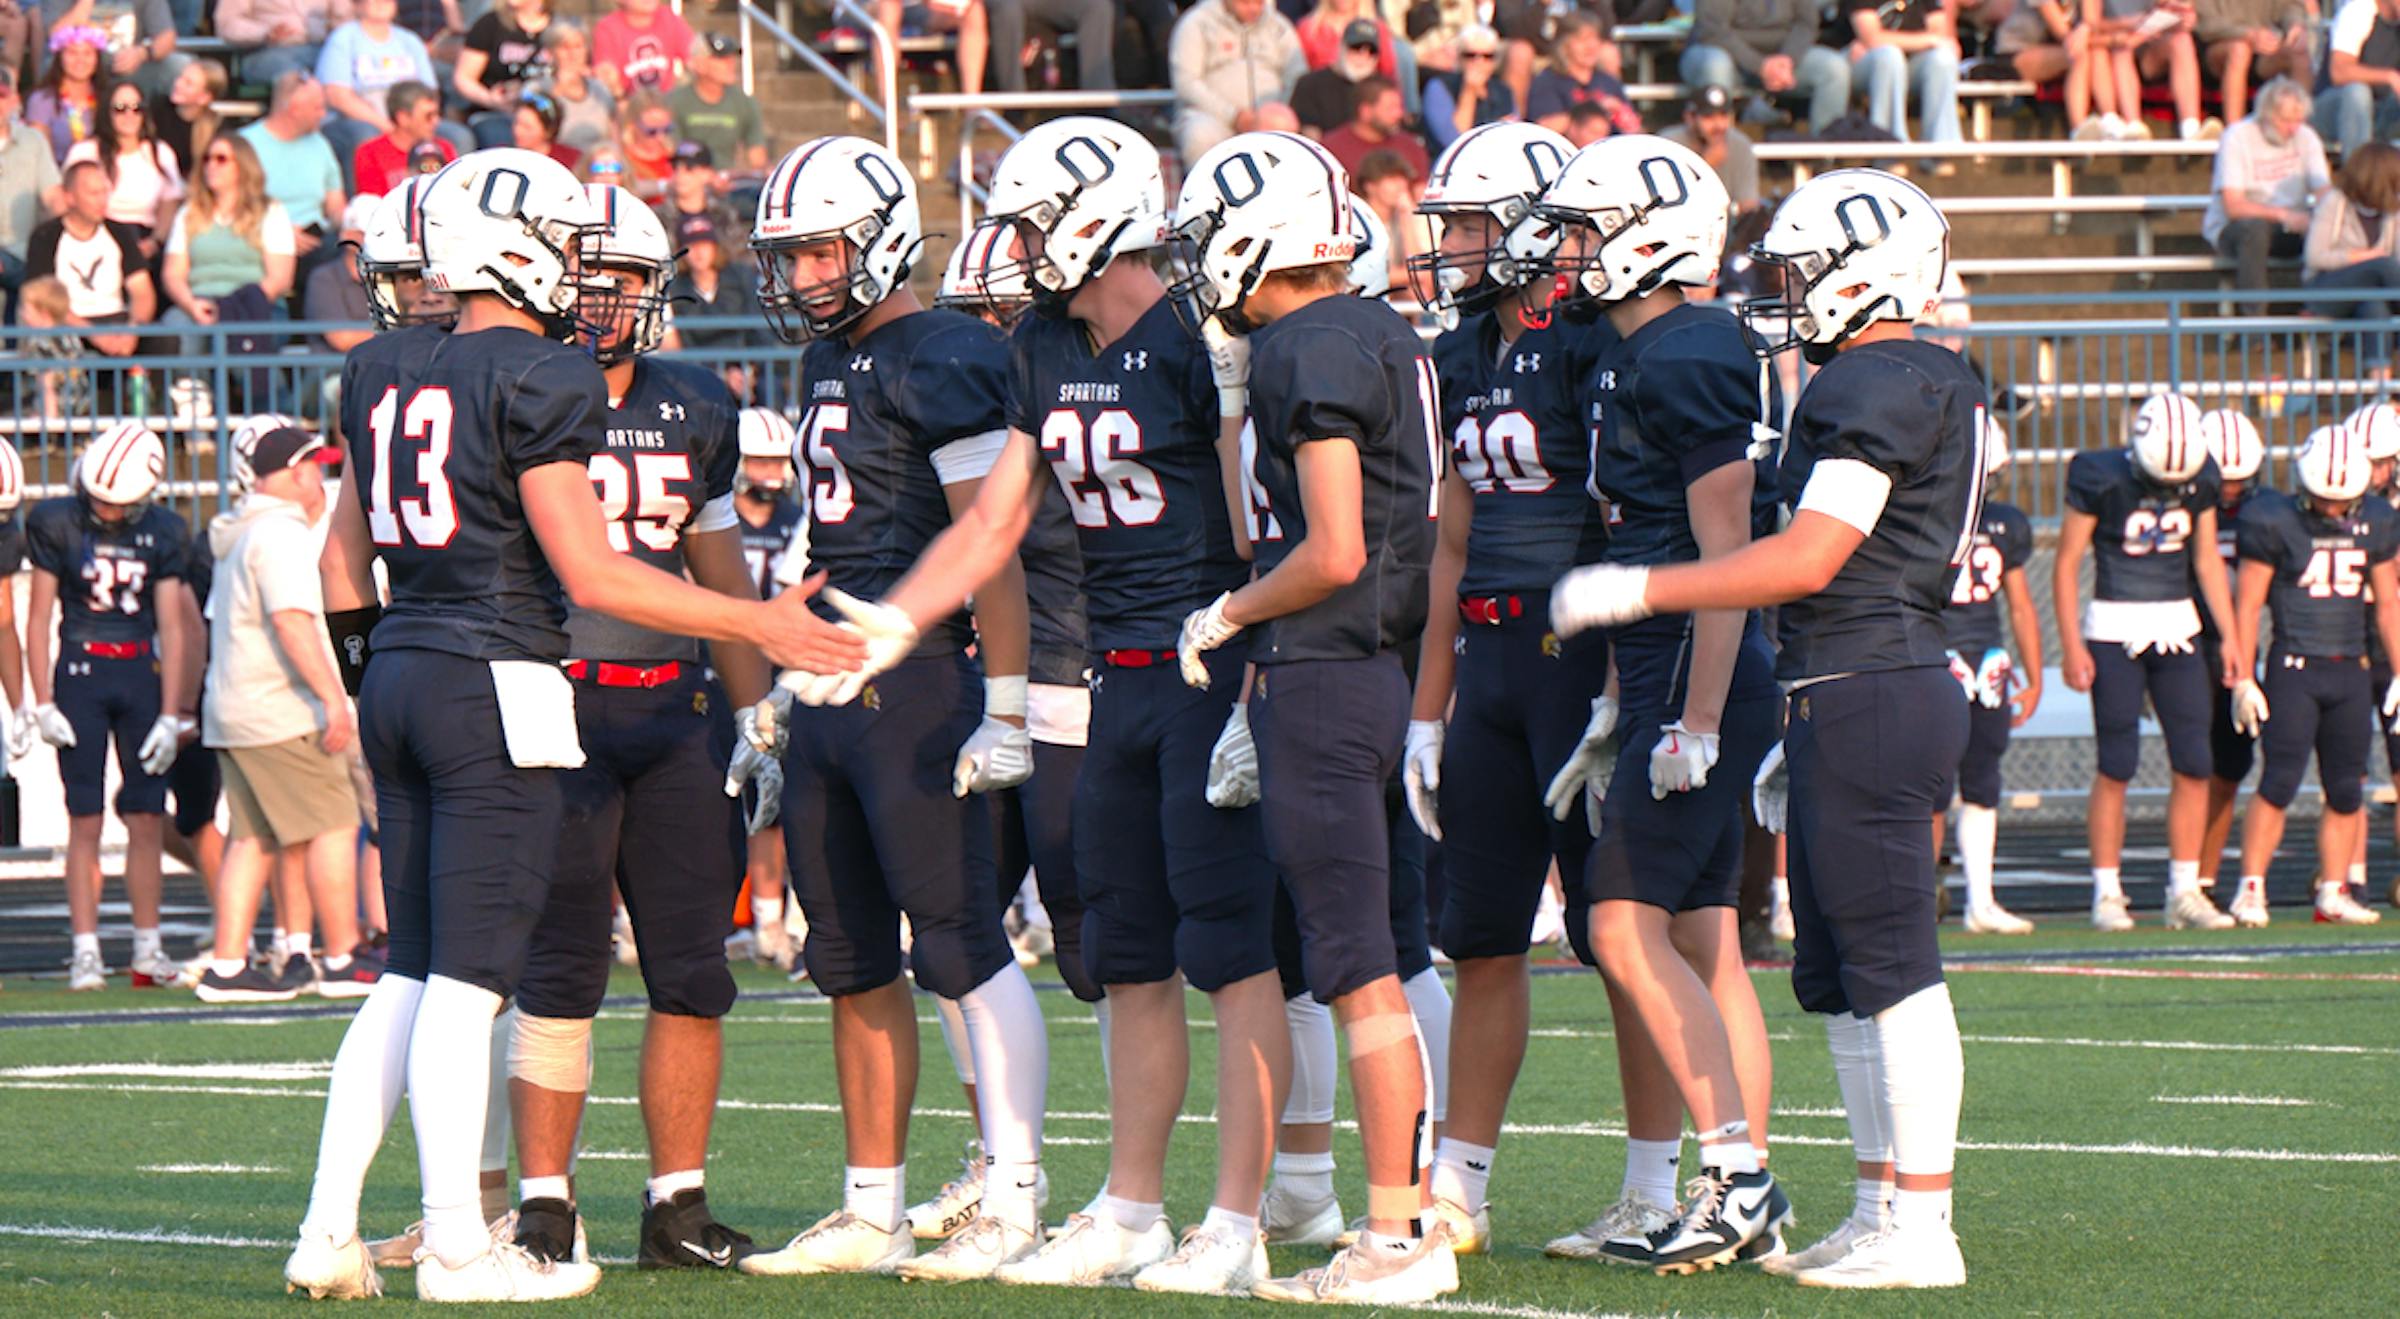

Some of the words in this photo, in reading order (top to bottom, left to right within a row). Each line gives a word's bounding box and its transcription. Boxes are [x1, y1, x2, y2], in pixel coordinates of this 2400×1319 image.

[1054, 136, 1115, 189] O
[1213, 152, 1265, 208] O
[478, 167, 531, 221] O
[1834, 193, 1891, 251] O
[1059, 383, 1122, 402] SPARTANS
[606, 429, 665, 448] ARTANS
[369, 385, 460, 549] 13
[1041, 408, 1168, 528] 26
[588, 454, 693, 552] 25
[2299, 549, 2368, 598] 45
[942, 1199, 983, 1233] BATT
